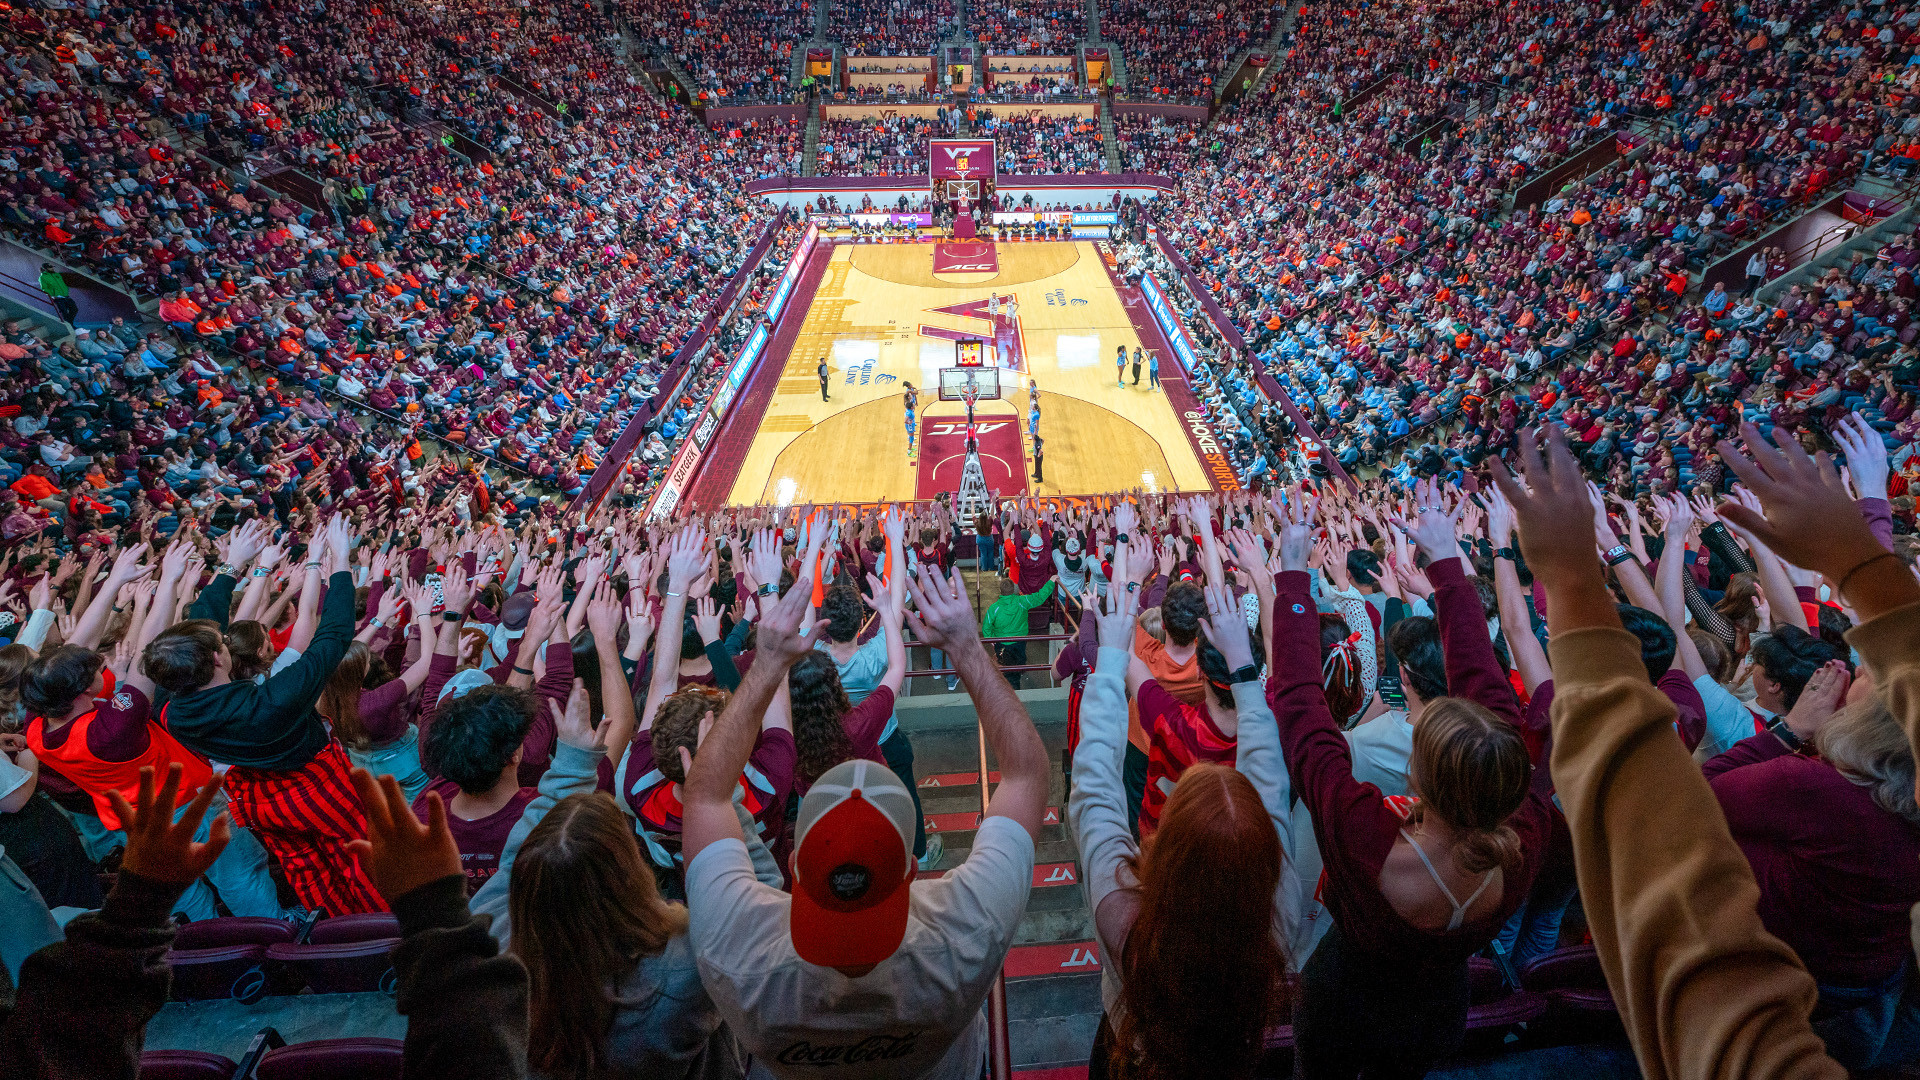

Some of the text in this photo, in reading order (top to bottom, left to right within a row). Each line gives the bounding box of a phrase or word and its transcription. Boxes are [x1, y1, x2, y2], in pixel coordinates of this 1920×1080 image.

[944, 148, 980, 159] VT
[1868, 200, 1876, 208] 6
[673, 446, 698, 487] SEATGEEK
[1044, 868, 1074, 881] VT
[1060, 949, 1098, 967] VT
